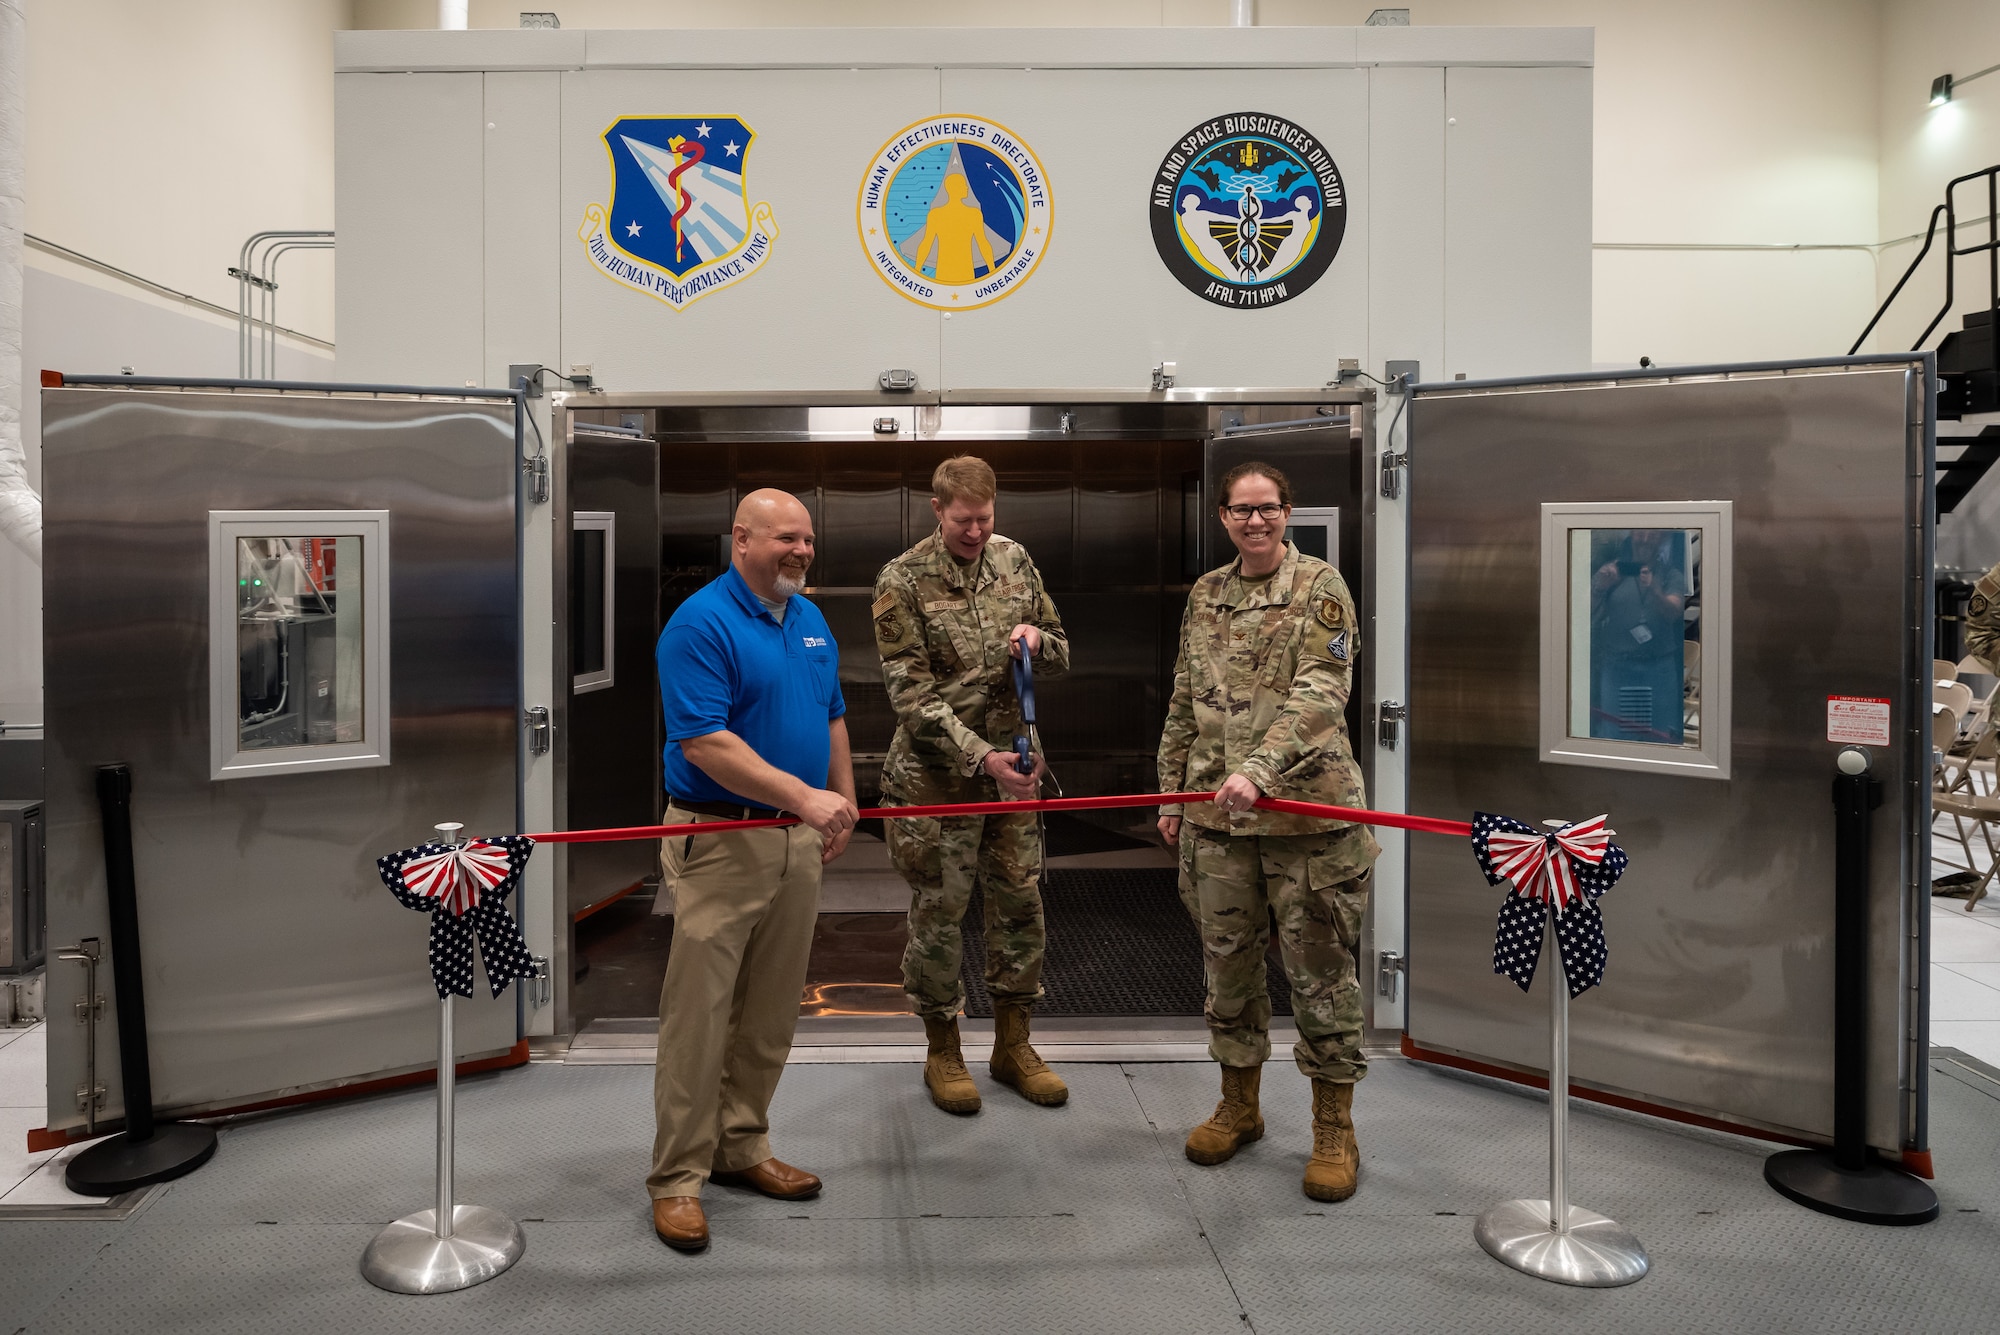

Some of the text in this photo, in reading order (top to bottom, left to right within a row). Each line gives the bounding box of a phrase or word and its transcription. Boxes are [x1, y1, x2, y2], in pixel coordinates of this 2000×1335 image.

[866, 123, 1044, 209] HUMAN EFFECTIVENESS DIRECTORATE
[1154, 115, 1342, 208] AIR AND SPACE BIOSCIENCES DIVISION
[606, 256, 654, 287] HUMAN
[655, 259, 745, 304] PERFORMANCE
[742, 232, 769, 265] WING
[876, 248, 1035, 298] INTEGRATED UNBEATABLE
[1204, 281, 1288, 305] AFRL 711 HPW
